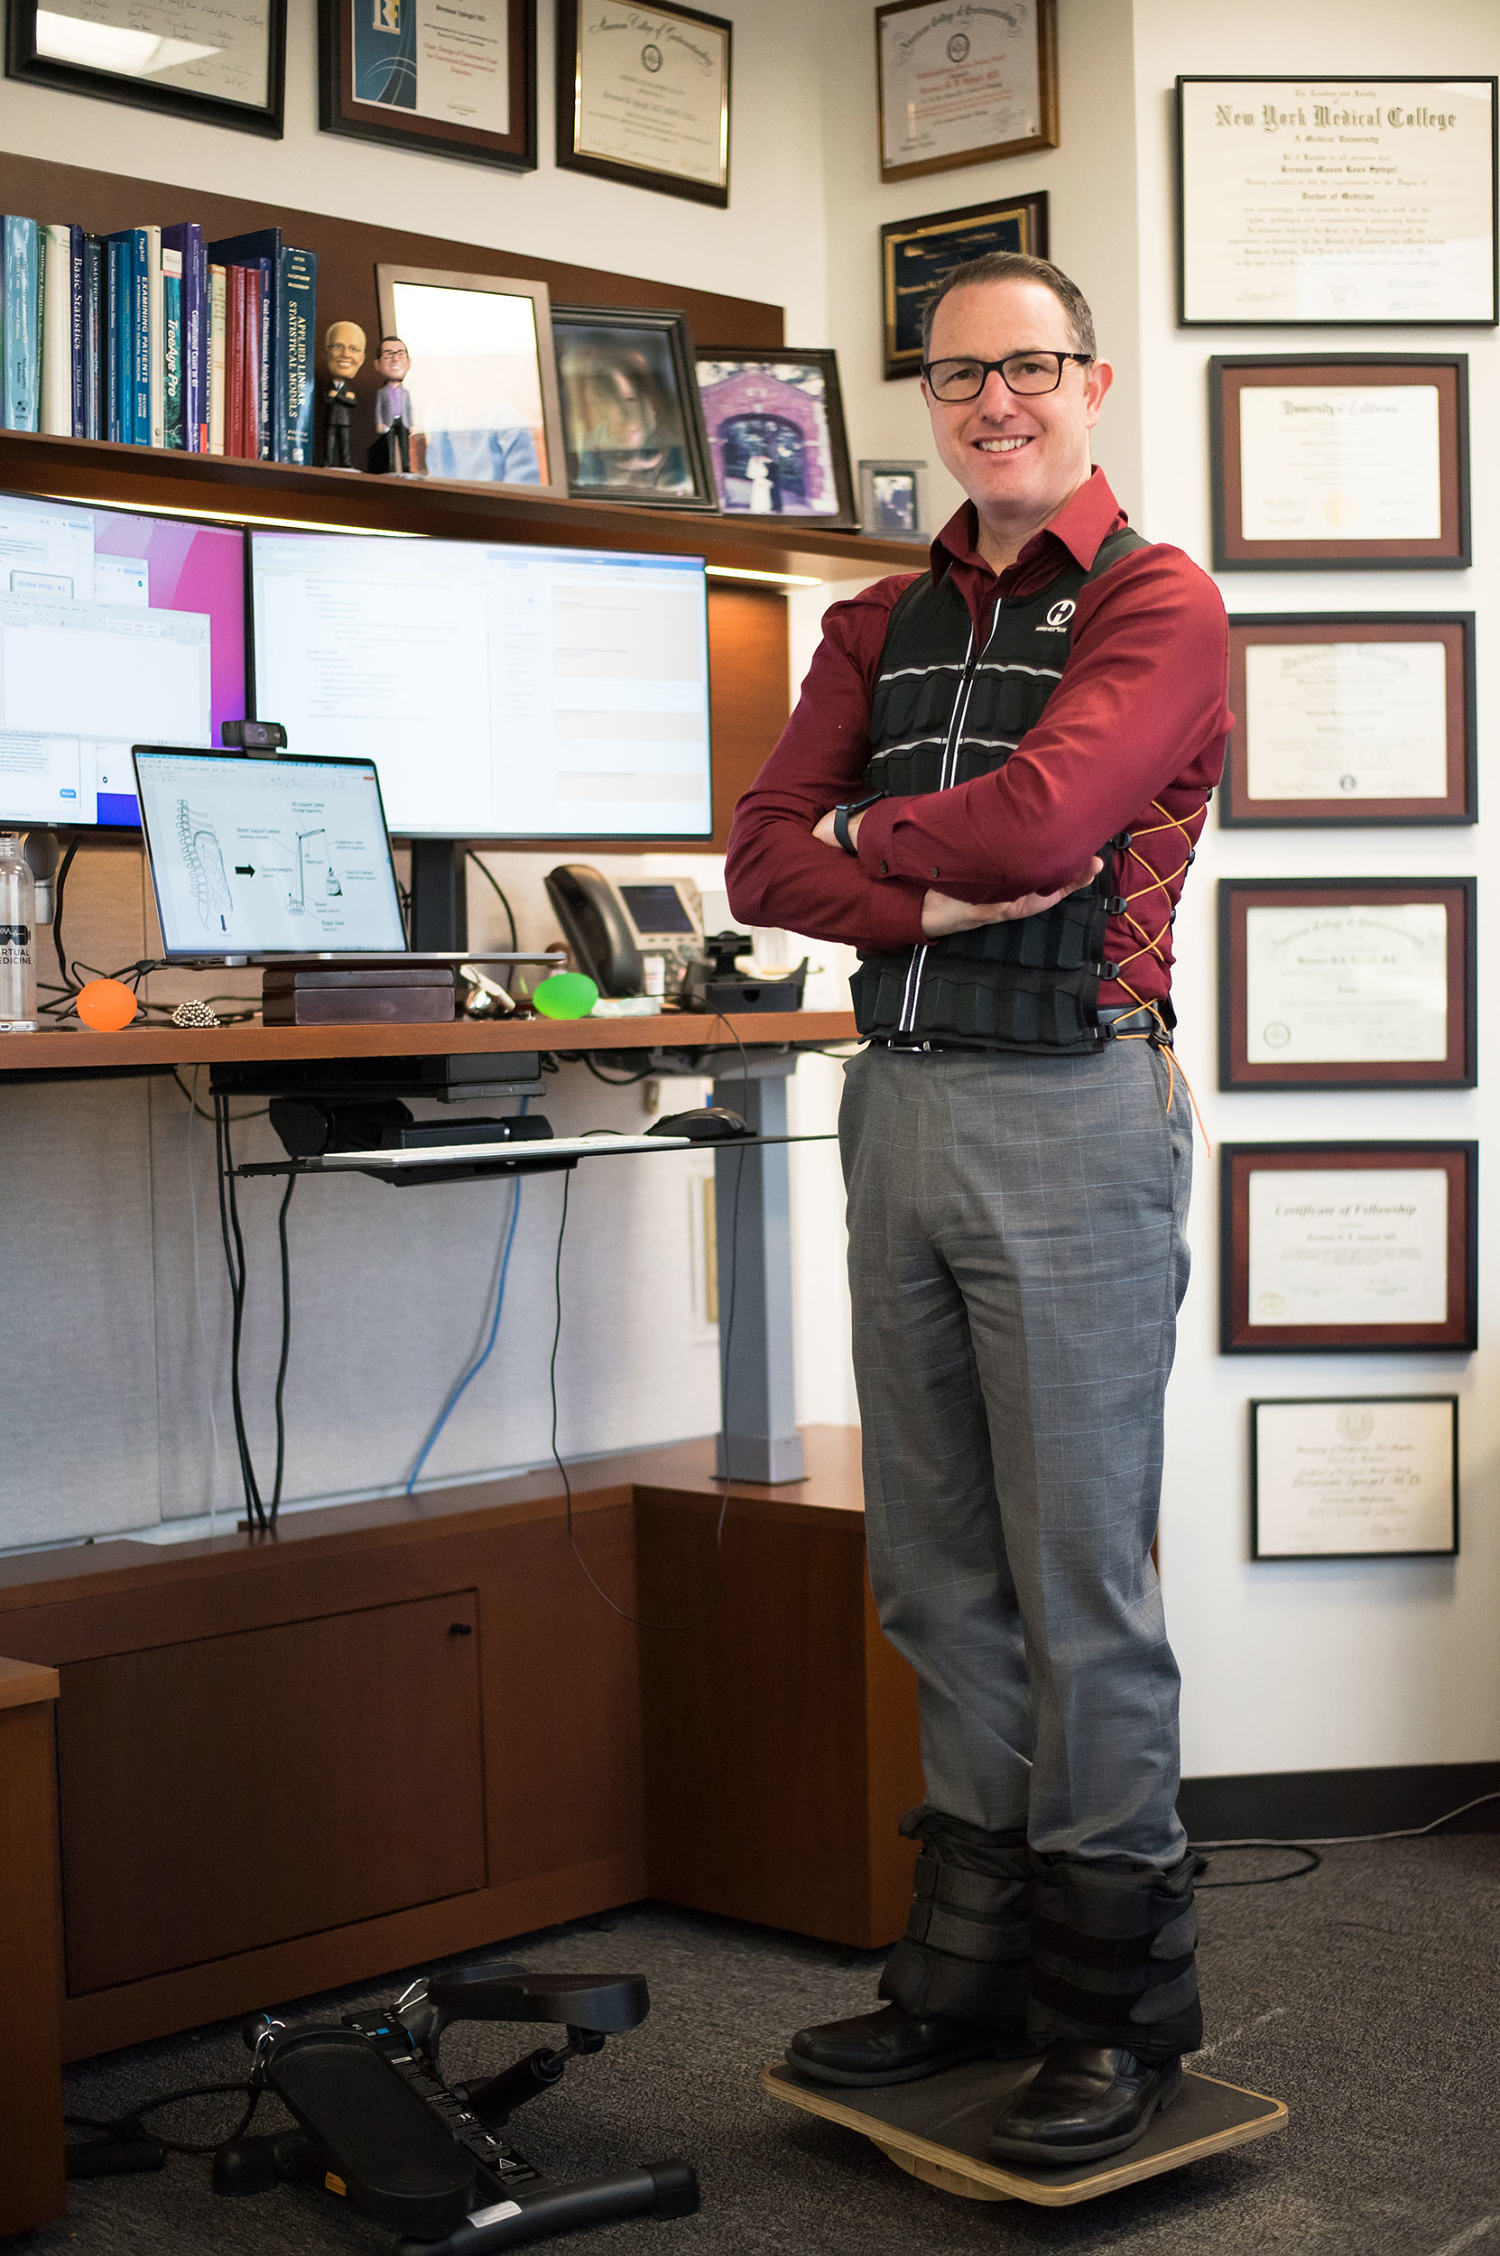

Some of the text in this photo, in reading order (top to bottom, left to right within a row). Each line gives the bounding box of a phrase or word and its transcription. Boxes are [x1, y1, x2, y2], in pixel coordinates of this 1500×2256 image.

[1215, 104, 1457, 133] New York Medical College
[73, 257, 83, 351] Basic Statistics
[141, 276, 149, 384] EXAMINING PATIENTS
[191, 309, 199, 350] Complicated
[261, 298, 270, 363] Cost-Effectiveness
[288, 300, 299, 369] STATISTICAL
[165, 319, 179, 397] TreeAge Pro
[191, 351, 199, 371] Cases
[261, 363, 269, 392] Analysis
[296, 316, 307, 406] APPLIED LINEAR
[261, 400, 269, 423] Health
[288, 371, 298, 418] MODELS
[1274, 1202, 1417, 1218] Certificate of Fellowship
